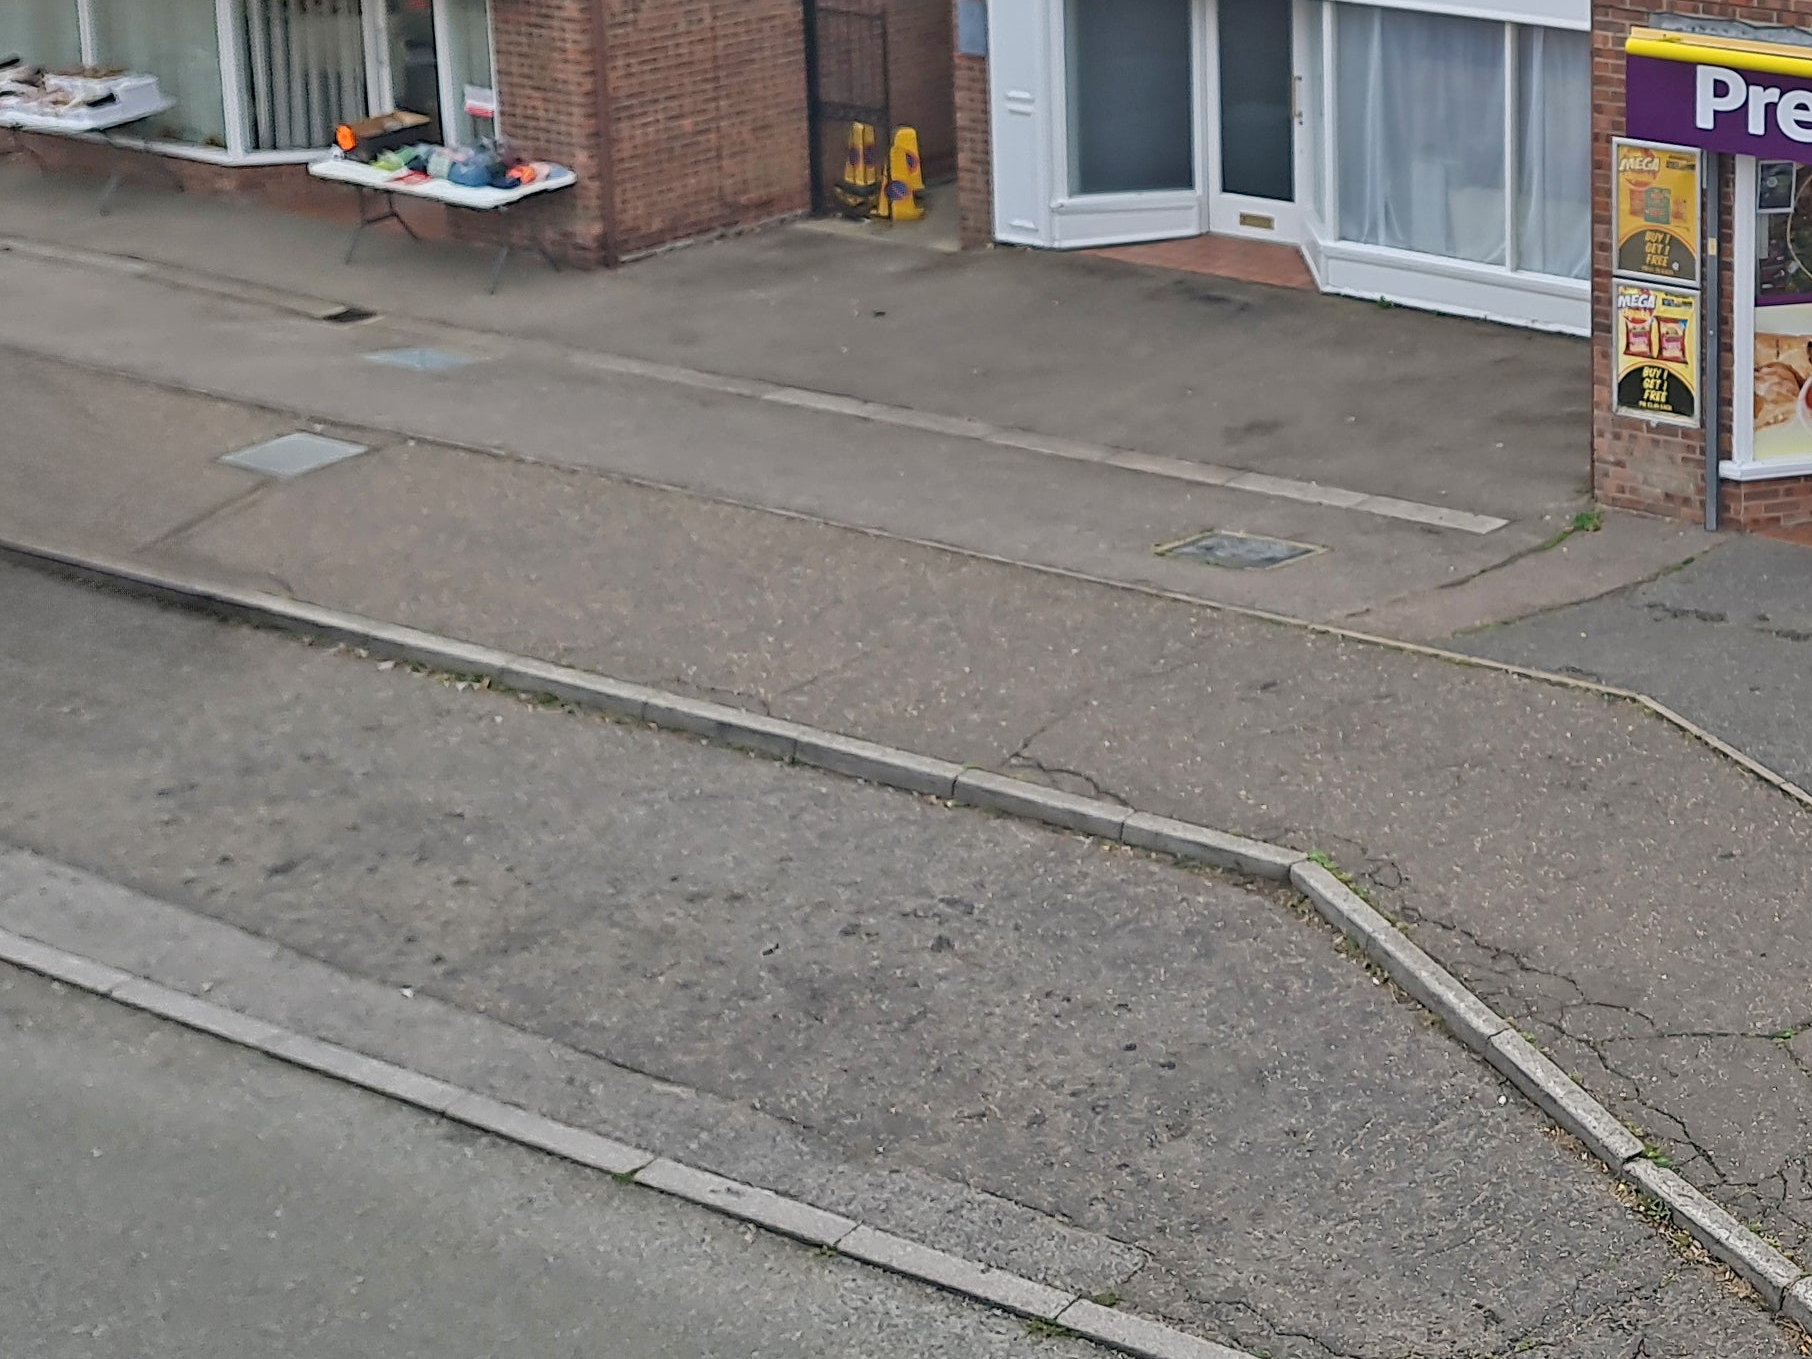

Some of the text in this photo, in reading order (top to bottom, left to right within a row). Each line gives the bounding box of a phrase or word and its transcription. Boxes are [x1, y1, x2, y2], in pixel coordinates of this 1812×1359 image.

[1619, 157, 1660, 171] MEGA
[1646, 254, 1669, 267] FREE
[1617, 294, 1656, 309] MEGA
[1642, 366, 1662, 379] BUY
[1642, 379, 1661, 390] GET
[1643, 390, 1668, 403] FREE
